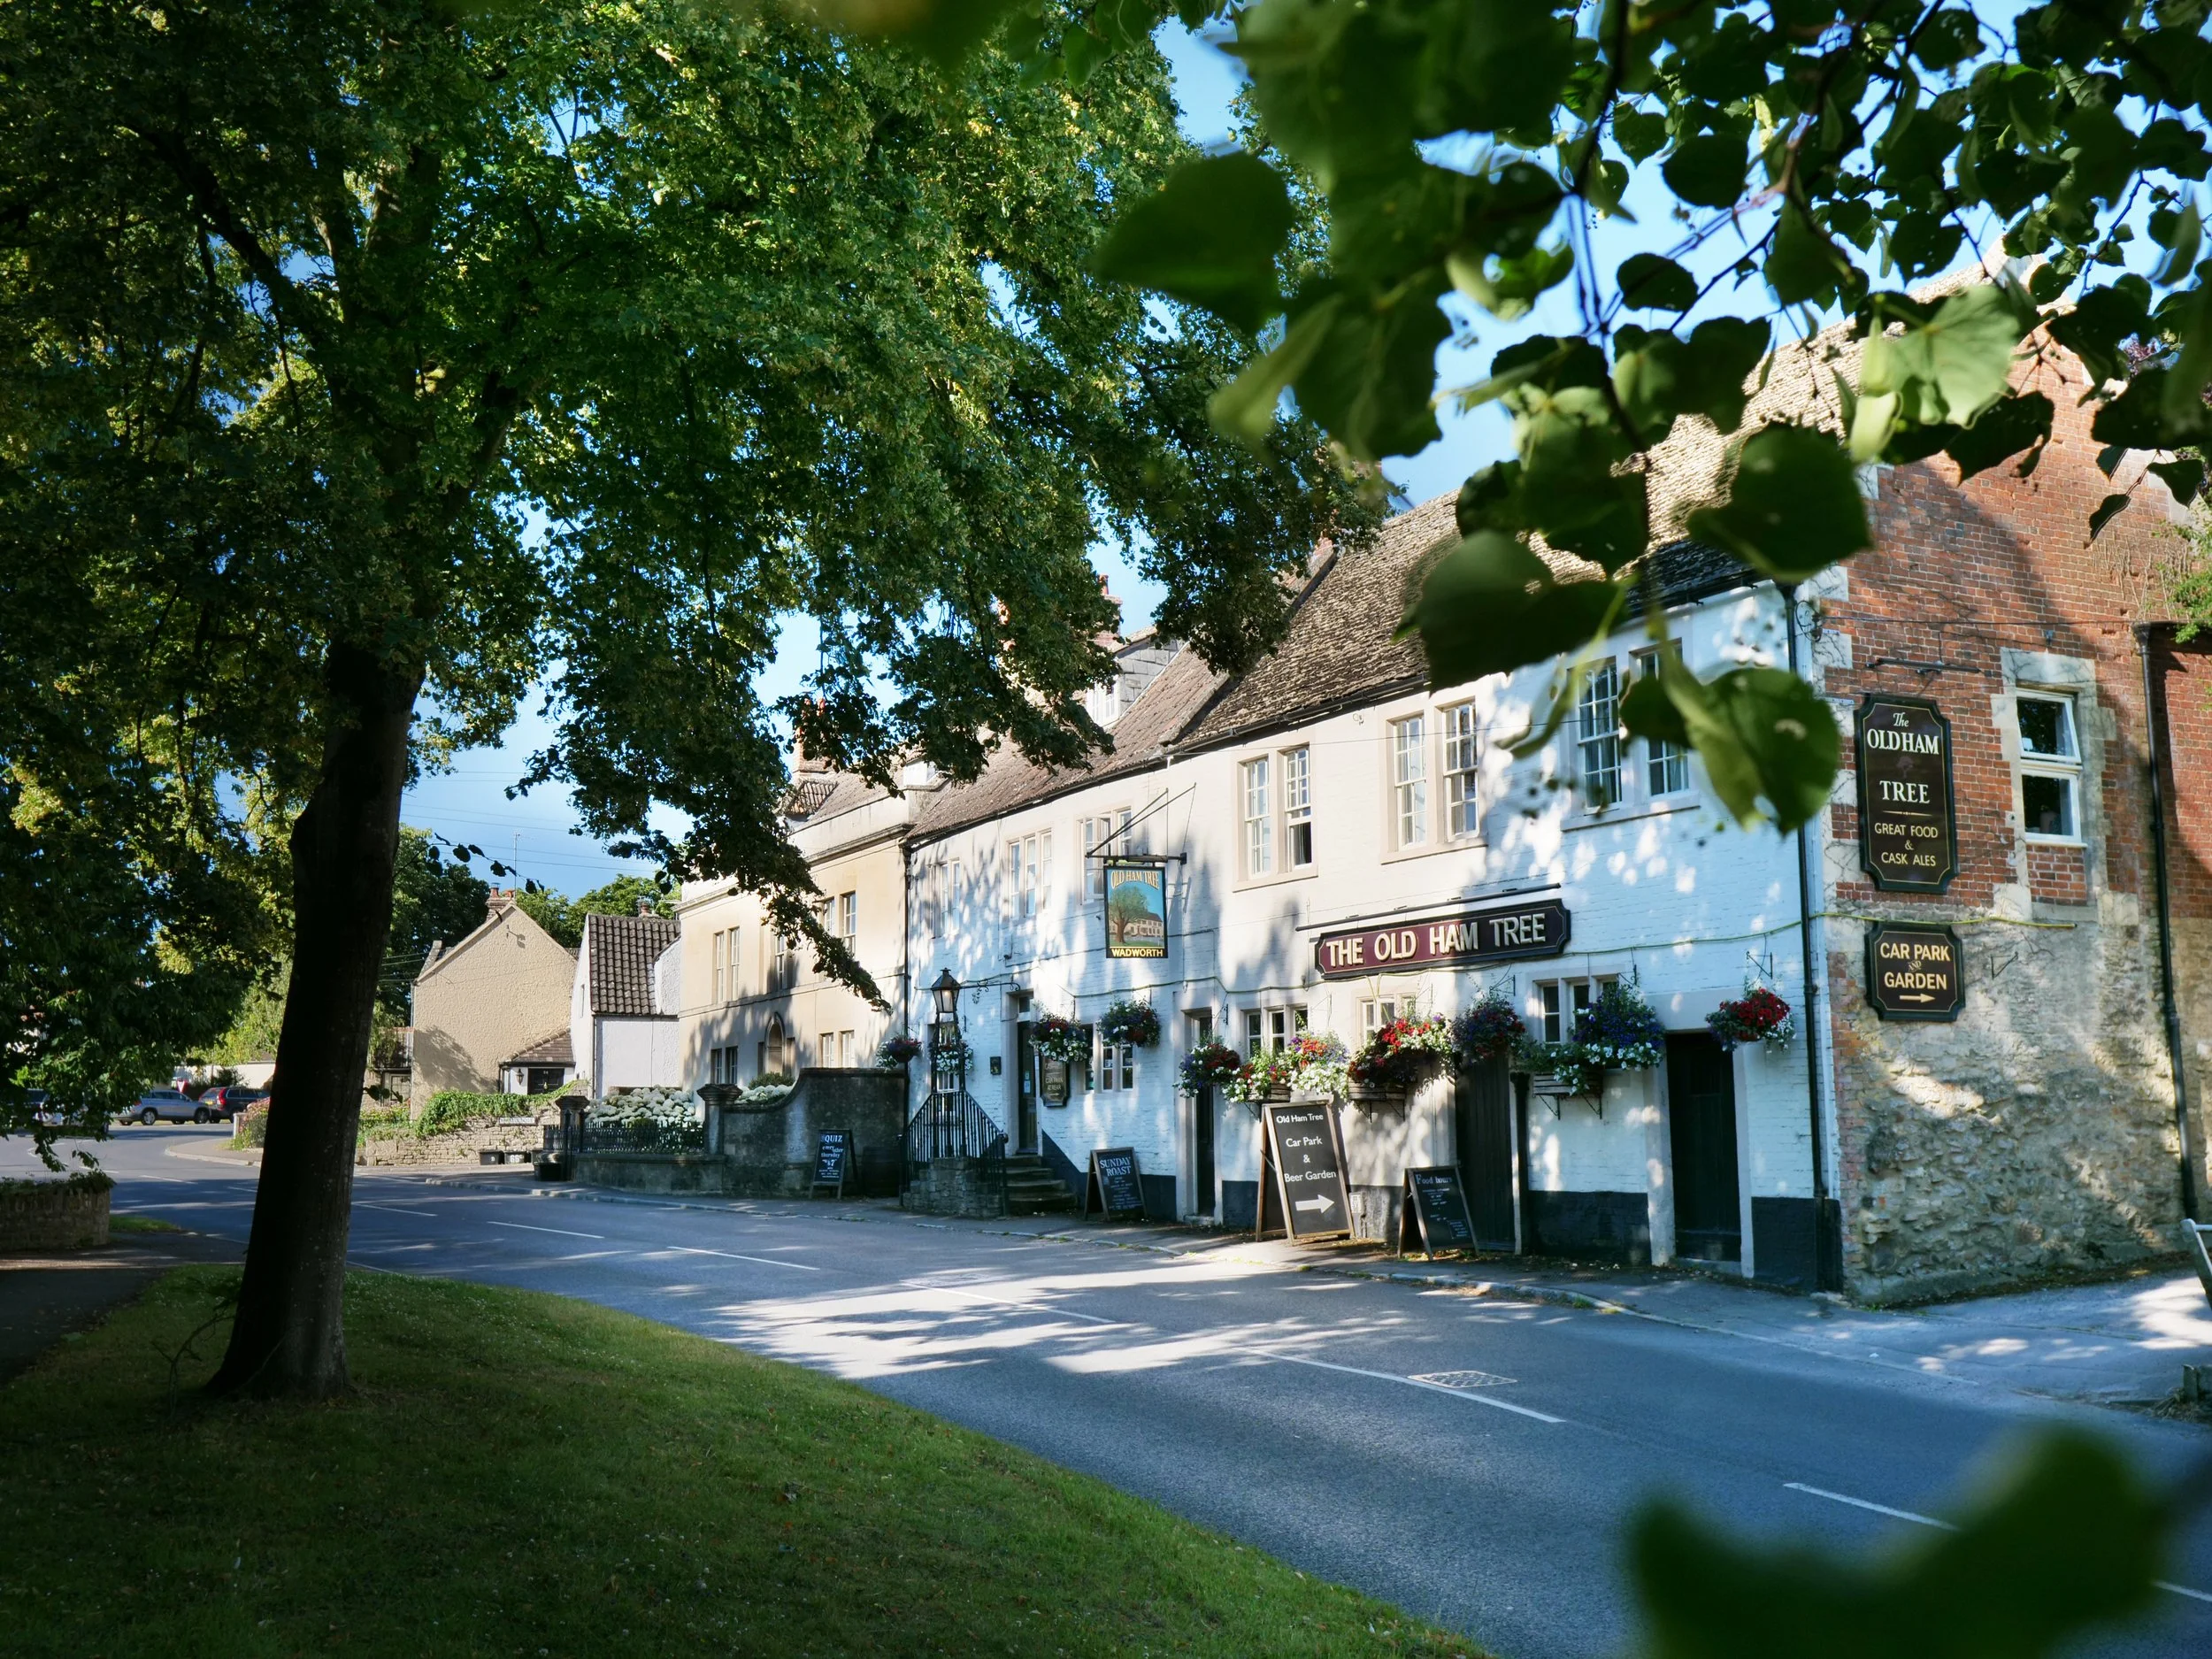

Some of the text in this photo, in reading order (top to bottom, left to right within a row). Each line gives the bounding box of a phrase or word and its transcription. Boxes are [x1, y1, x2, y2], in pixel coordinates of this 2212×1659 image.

[1893, 711, 1909, 727] The
[1879, 780, 1931, 804] TREE
[1874, 822, 1939, 839] GREAT FOOD
[1904, 839, 1915, 850] &
[1880, 851, 1937, 867] CASK ALES
[1110, 870, 1160, 891] OLD HAM TREE
[1326, 912, 1547, 968] THE OLD HAM TREE
[1111, 949, 1164, 957] WADWORTH
[1879, 941, 1951, 962] CAR PARK
[1884, 971, 1947, 990] GARDEN
[1276, 1115, 1290, 1124] Old
[1291, 1114, 1308, 1123] Ham
[825, 1134, 843, 1143] QUIZ
[1286, 1136, 1323, 1148] Car Park
[1099, 1156, 1131, 1169] SUNDAY
[1302, 1154, 1310, 1164] &
[1106, 1166, 1132, 1177] ROAST
[1284, 1170, 1337, 1183] Beer Garden
[1416, 1173, 1433, 1184] Food
